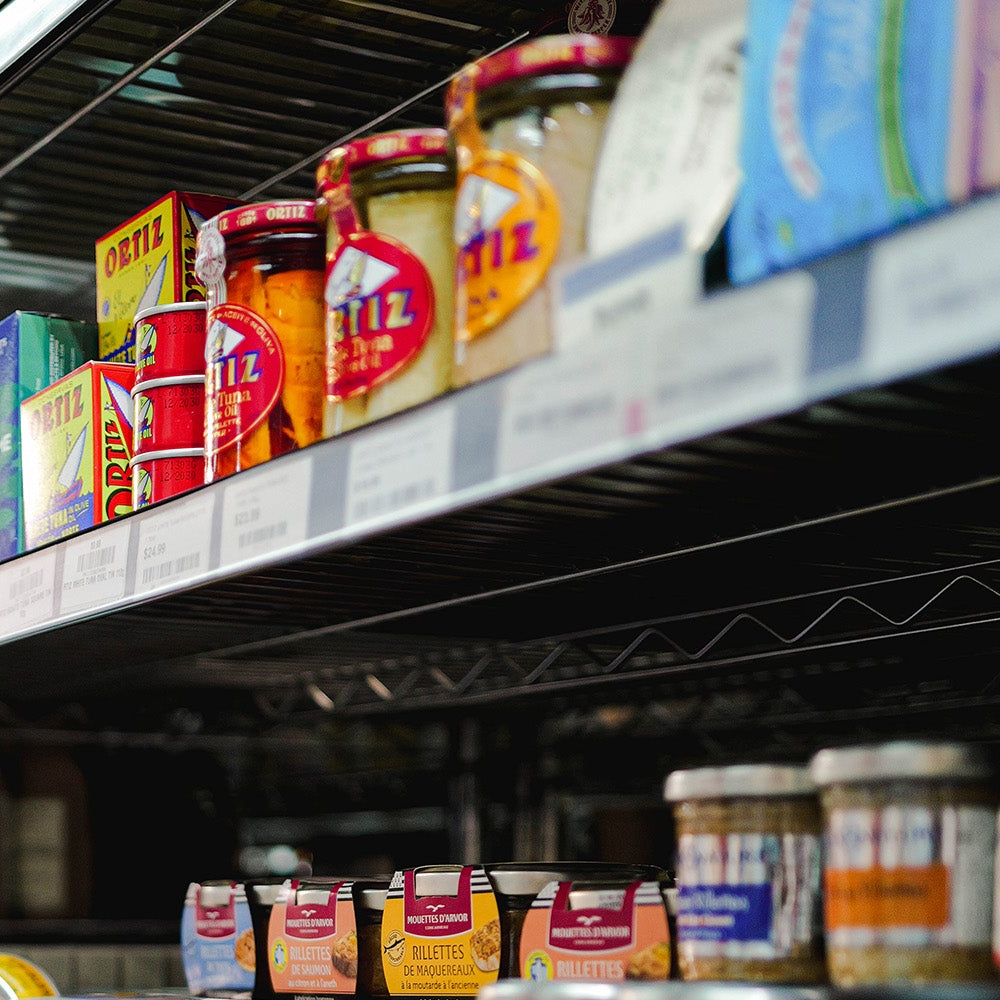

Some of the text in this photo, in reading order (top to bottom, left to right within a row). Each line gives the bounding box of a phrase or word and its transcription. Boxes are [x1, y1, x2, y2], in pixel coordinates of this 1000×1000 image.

[265, 205, 306, 221] ORTIZ
[104, 214, 164, 278] ORTIZ
[460, 220, 539, 277] TIZ
[332, 288, 416, 342] TIZ
[212, 350, 263, 391] TIZ
[218, 389, 252, 407] Tuna
[31, 384, 85, 441] ORTIZ
[224, 403, 238, 418] Oil
[105, 419, 133, 520] ORTIZ
[407, 912, 469, 924] MOUETTES D'ARVOR
[290, 946, 332, 961] RILLETTES
[412, 945, 465, 960] RILLETTES
[291, 964, 332, 977] DE SAUMON
[403, 964, 476, 979] DE MAQUEREAUX
[556, 960, 624, 979] RILLETTES
[412, 980, 442, 990] moutarde
[448, 980, 480, 990] l'ancienne
